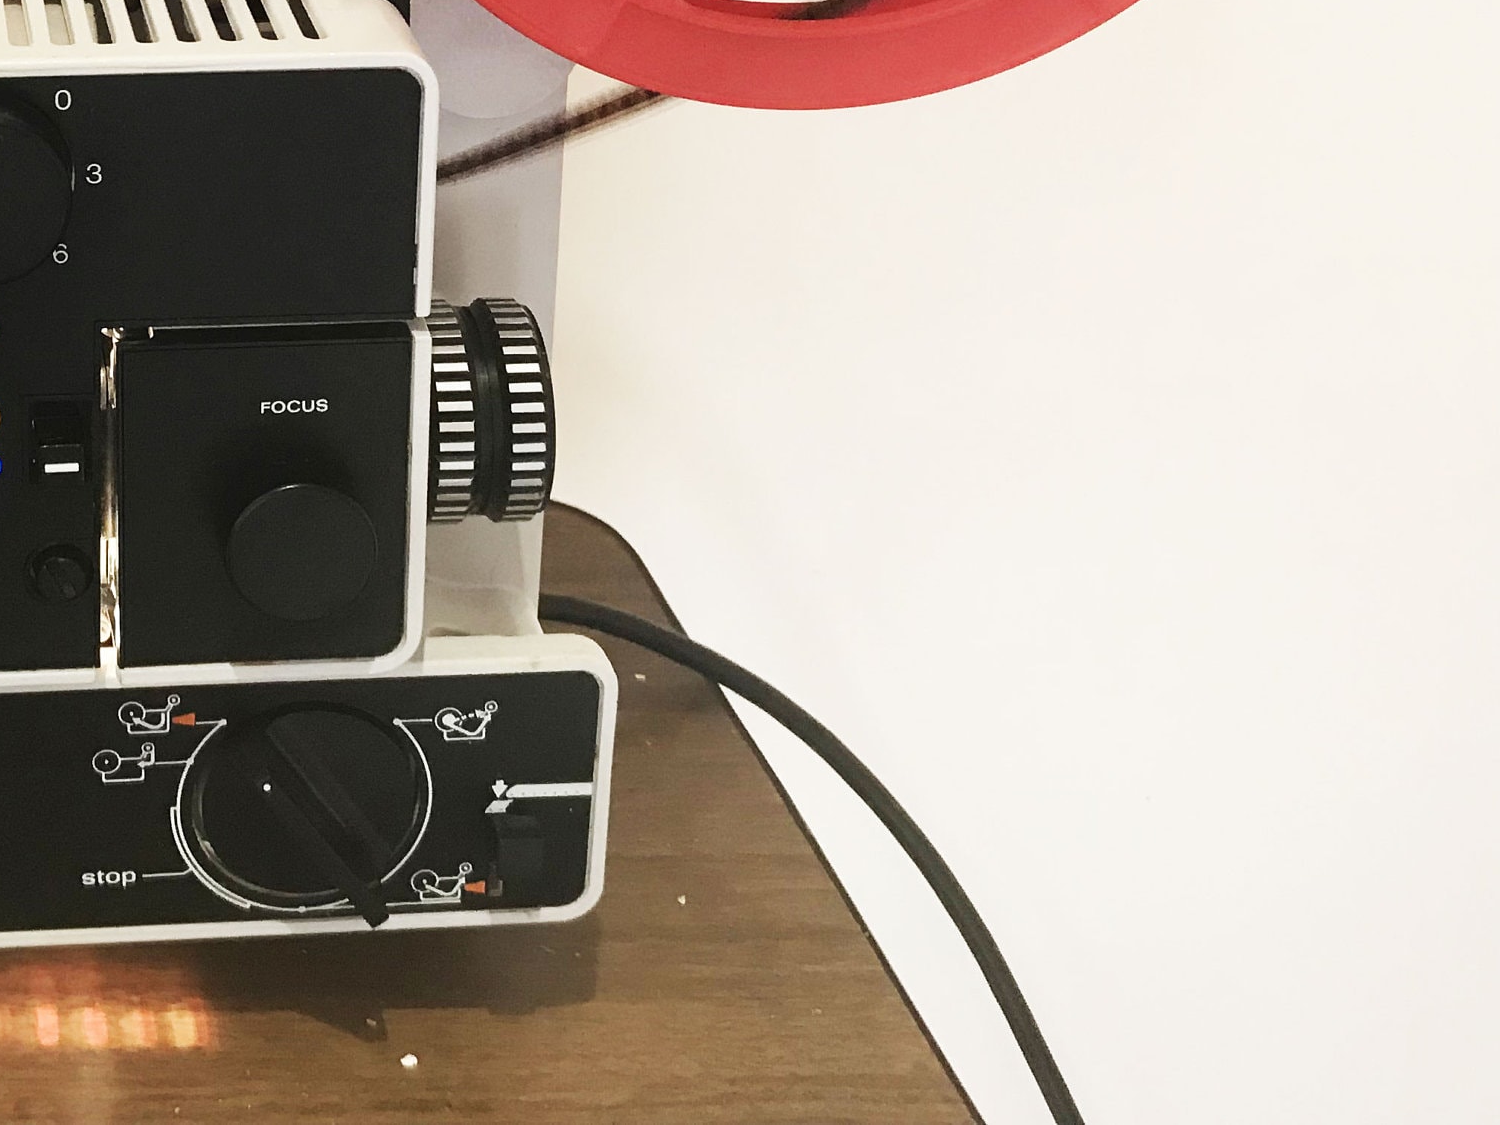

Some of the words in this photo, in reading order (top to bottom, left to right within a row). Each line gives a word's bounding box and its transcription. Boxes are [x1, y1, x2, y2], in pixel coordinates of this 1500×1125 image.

[54, 89, 72, 111] 0
[85, 163, 103, 184] 3
[52, 243, 69, 264] 6
[260, 398, 329, 415] FOCUS
[81, 869, 137, 888] stop
